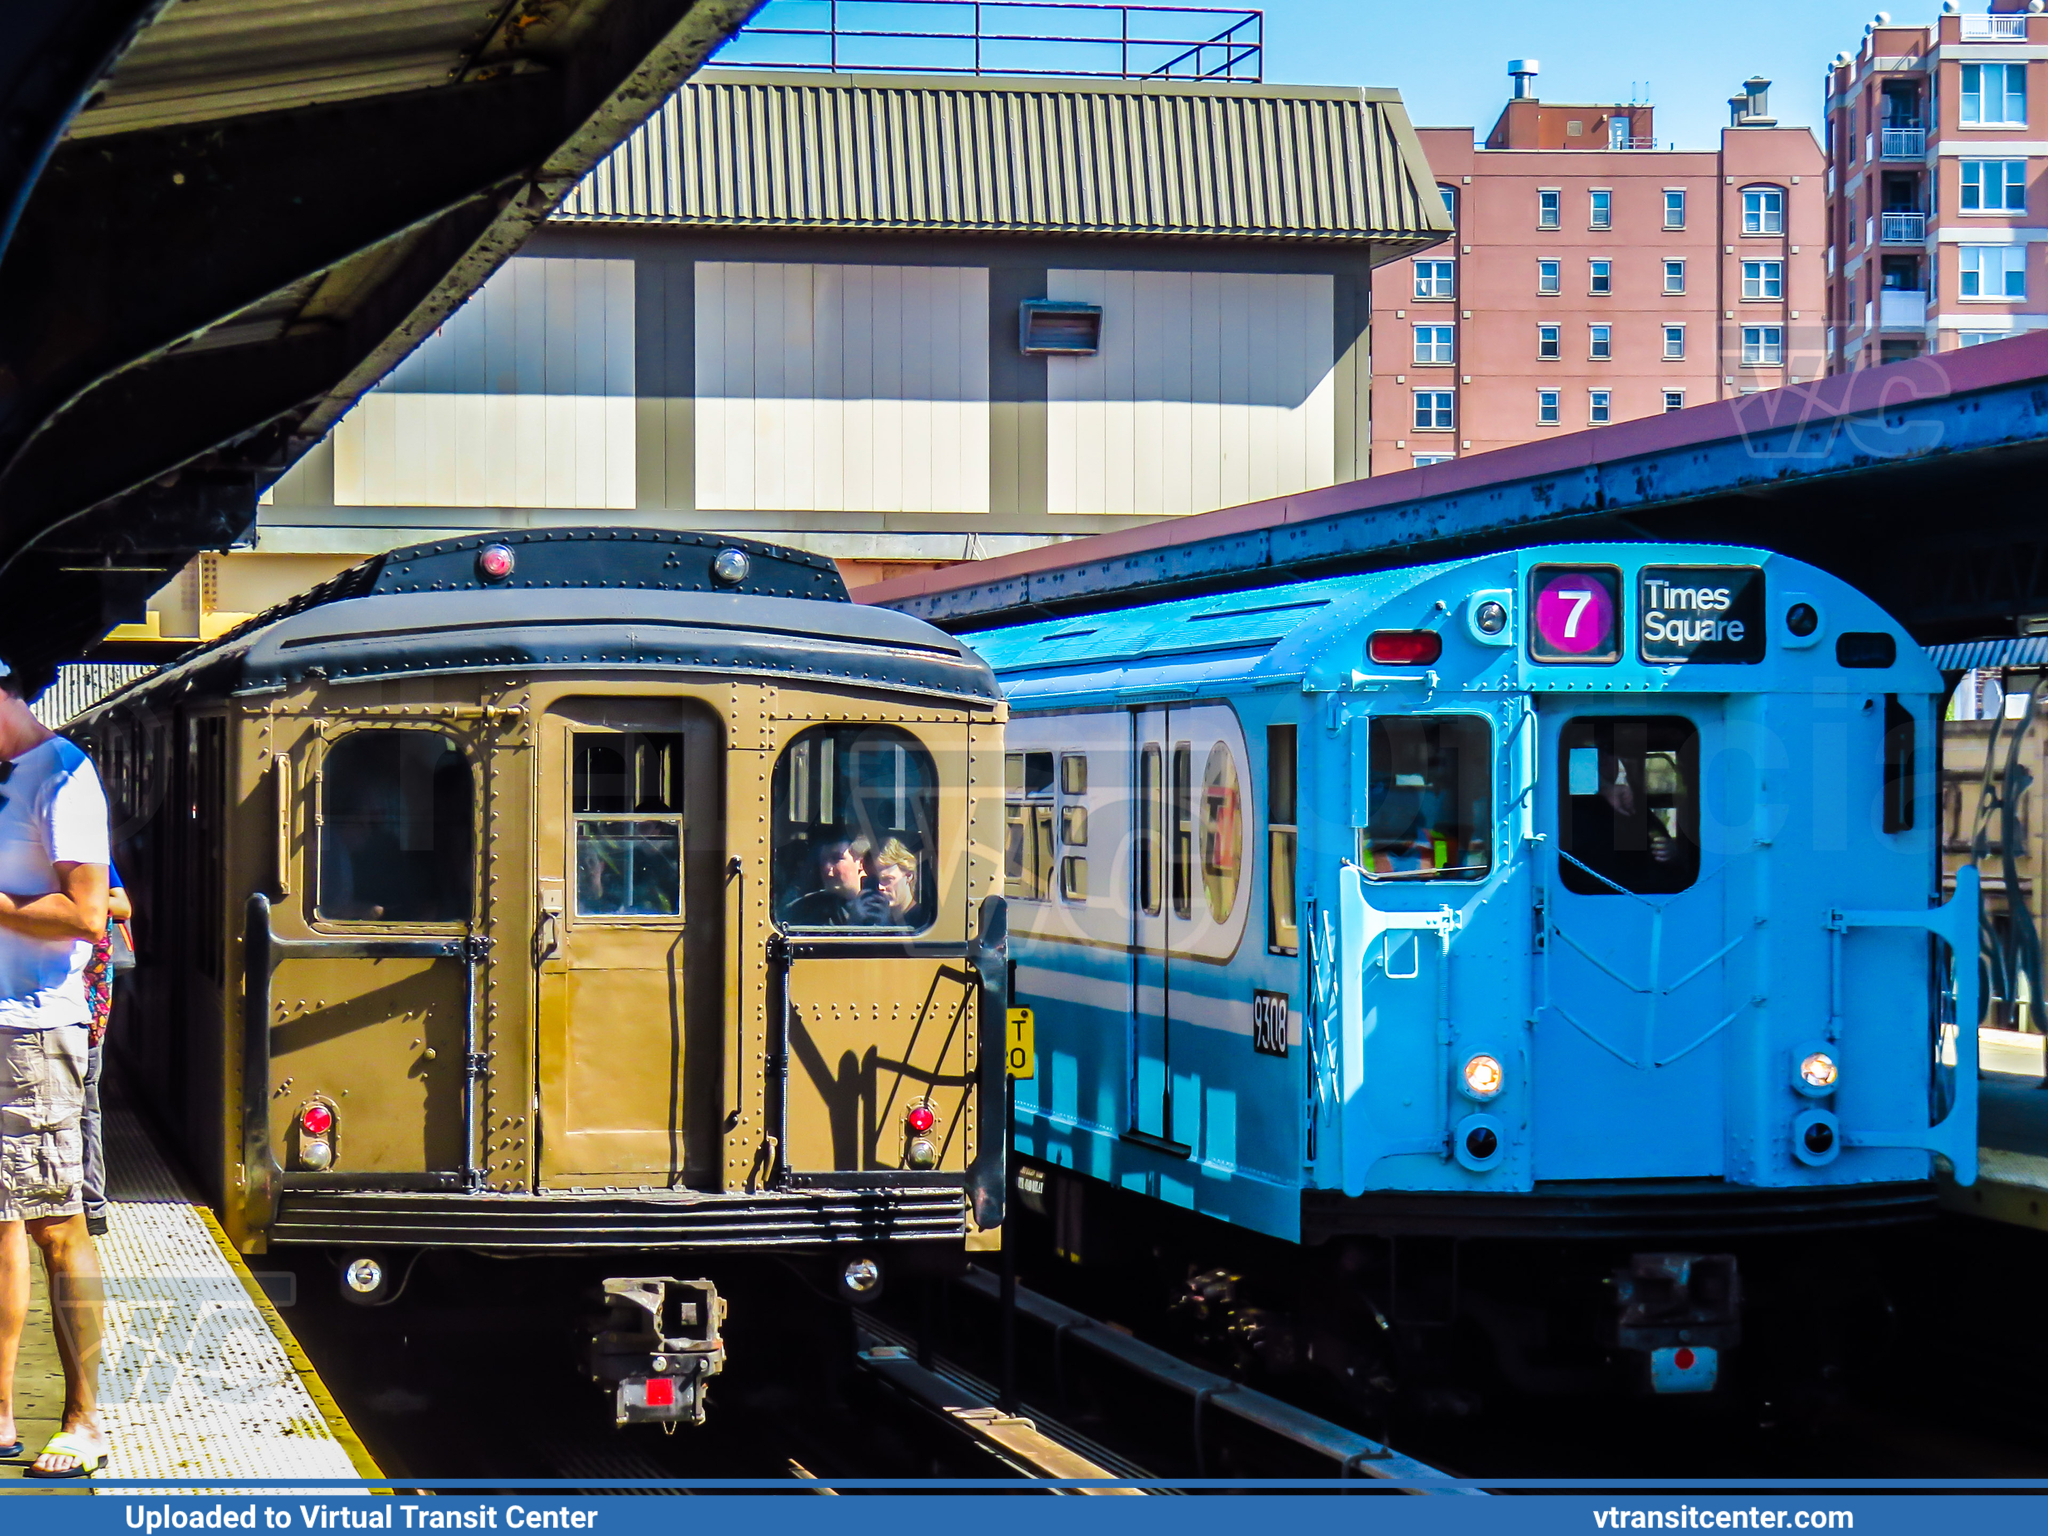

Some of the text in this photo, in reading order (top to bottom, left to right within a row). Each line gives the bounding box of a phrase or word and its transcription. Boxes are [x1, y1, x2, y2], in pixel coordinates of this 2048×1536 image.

[1558, 590, 1591, 637] 7
[1644, 580, 1730, 611] Times
[1644, 611, 1745, 647] Square
[1254, 995, 1287, 1053] 9308
